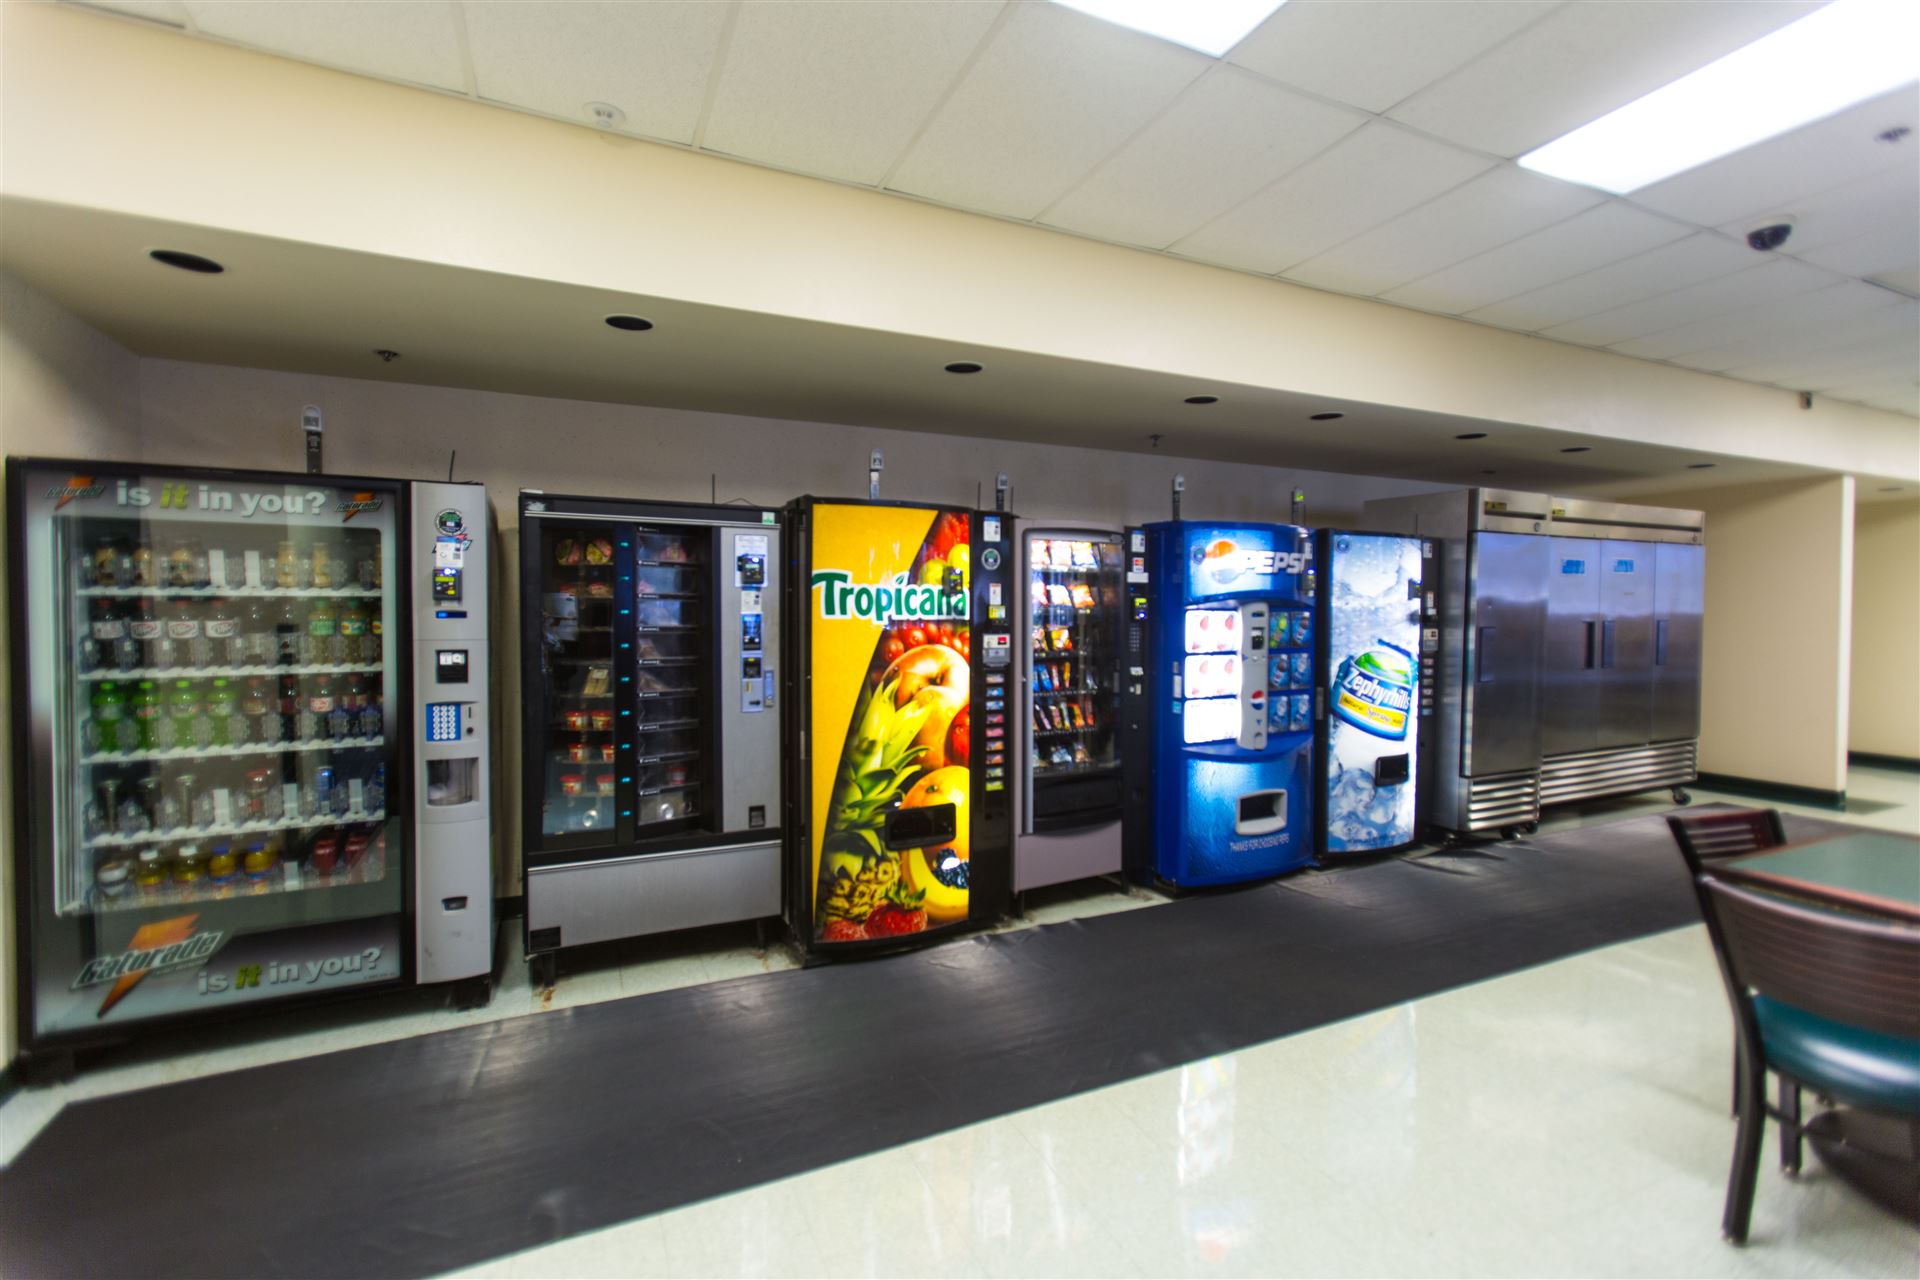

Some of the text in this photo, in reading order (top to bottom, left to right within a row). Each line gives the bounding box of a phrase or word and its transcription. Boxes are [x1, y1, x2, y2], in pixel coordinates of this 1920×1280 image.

[116, 480, 326, 518] is it in you?
[811, 571, 967, 622] Tropicana
[1342, 666, 1412, 711] Zephyrhills
[72, 931, 223, 990] Gatorade
[199, 971, 230, 995] is
[235, 964, 263, 990] it
[269, 960, 299, 985] in
[305, 946, 382, 984] you?
